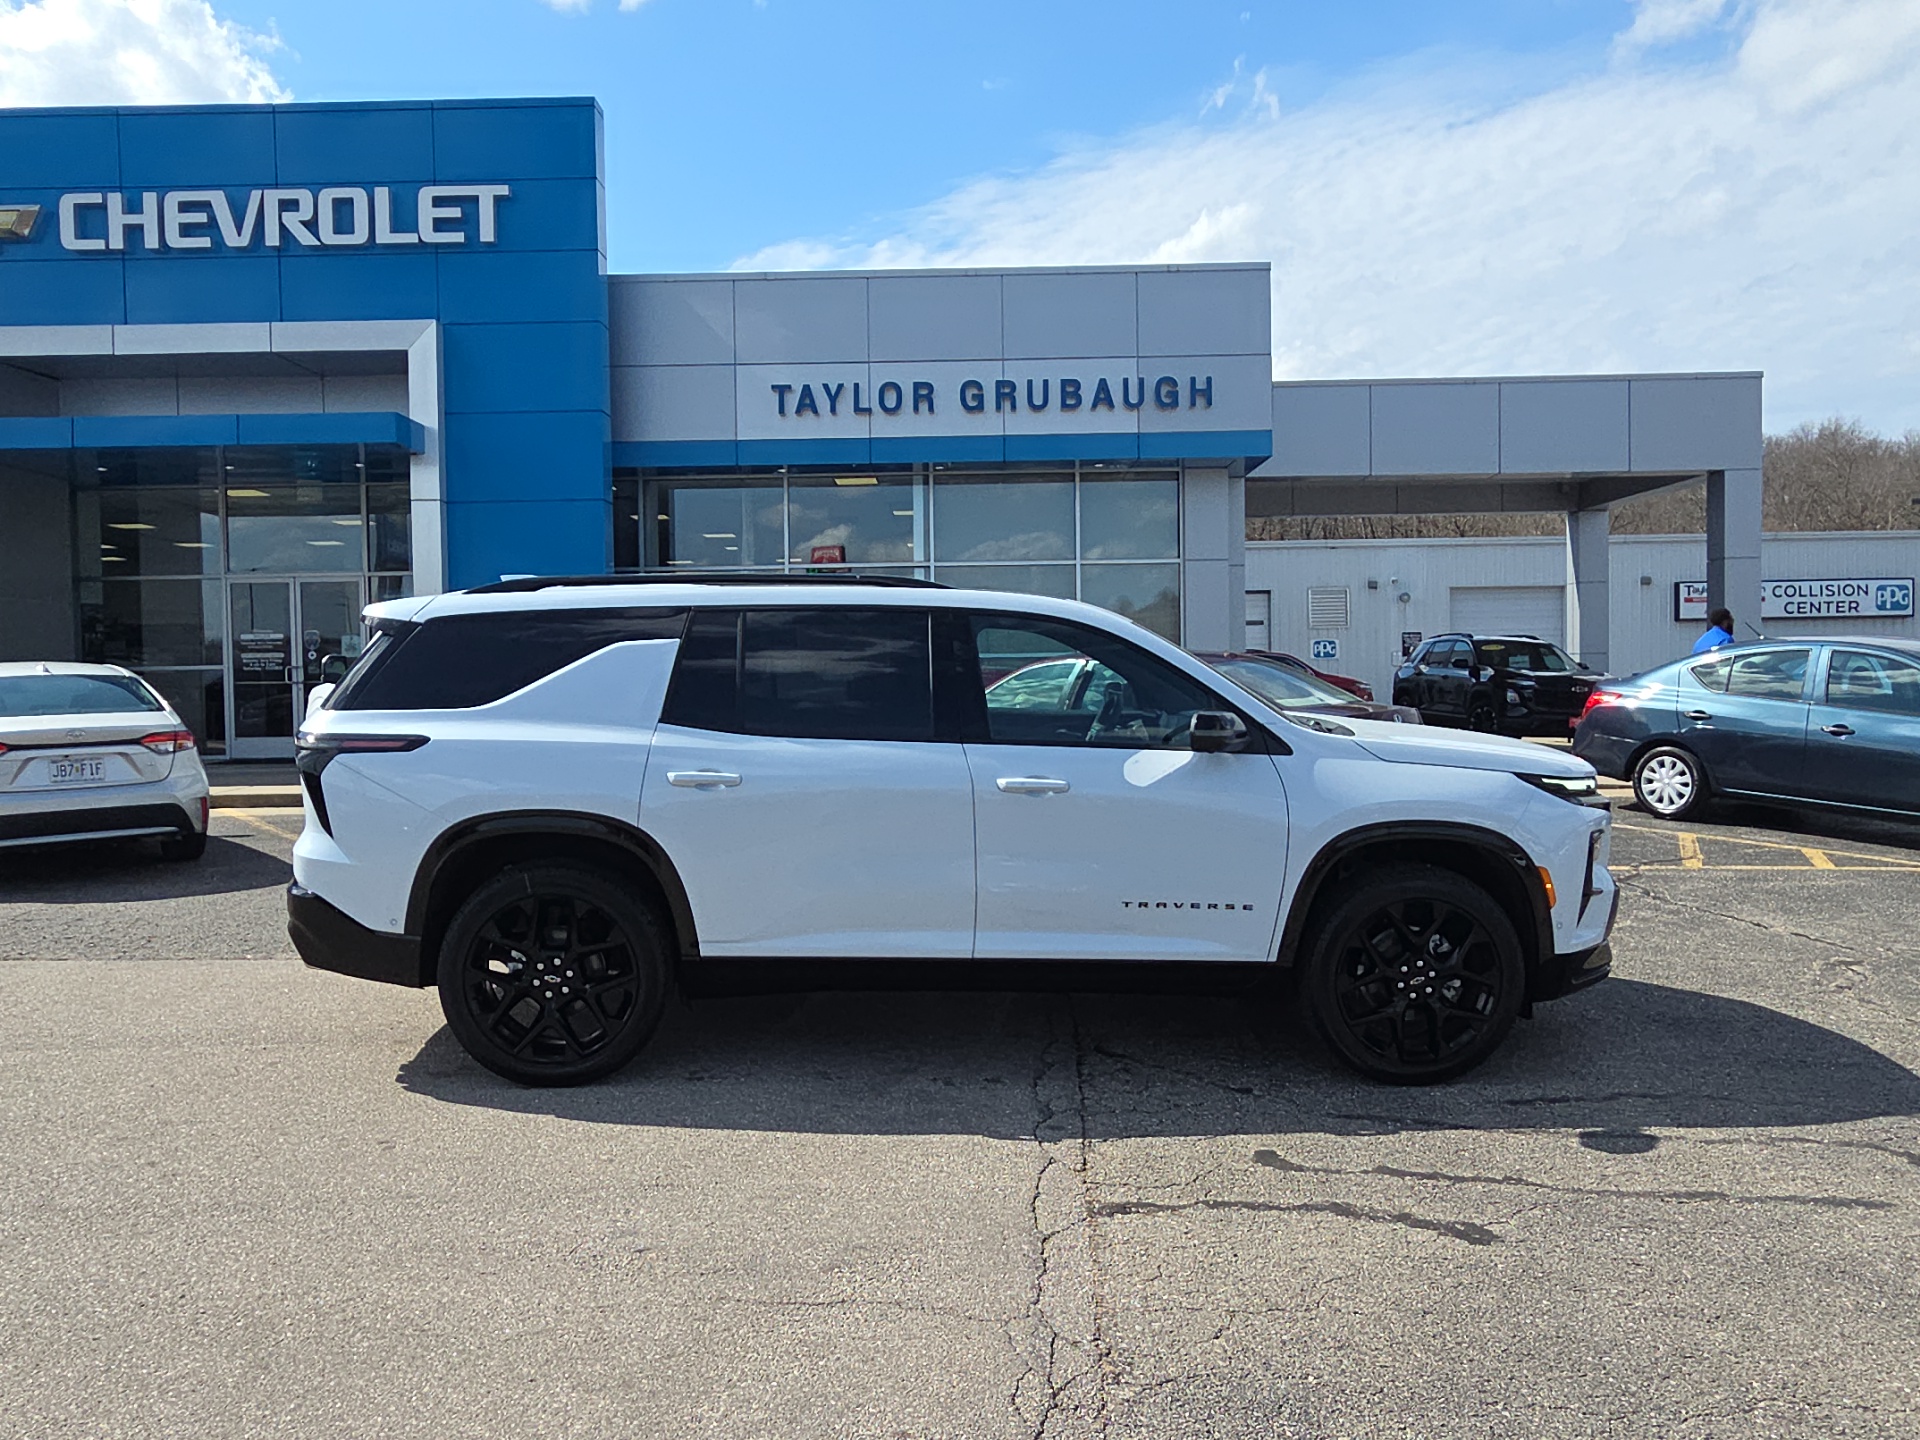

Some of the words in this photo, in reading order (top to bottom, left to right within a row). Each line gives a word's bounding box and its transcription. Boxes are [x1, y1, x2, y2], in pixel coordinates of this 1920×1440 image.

[58, 184, 511, 251] CHEVROLET
[770, 381, 936, 417] TAYLOR
[959, 376, 1213, 414] GRUBAUGH
[1772, 583, 1870, 599] COLLISION
[1876, 586, 1910, 610] PPG
[1783, 600, 1861, 615] CENTER
[1314, 641, 1337, 657] PPG
[52, 763, 74, 778] JB7
[80, 762, 103, 776] F1F
[1121, 901, 1254, 912] TRAVERSE
